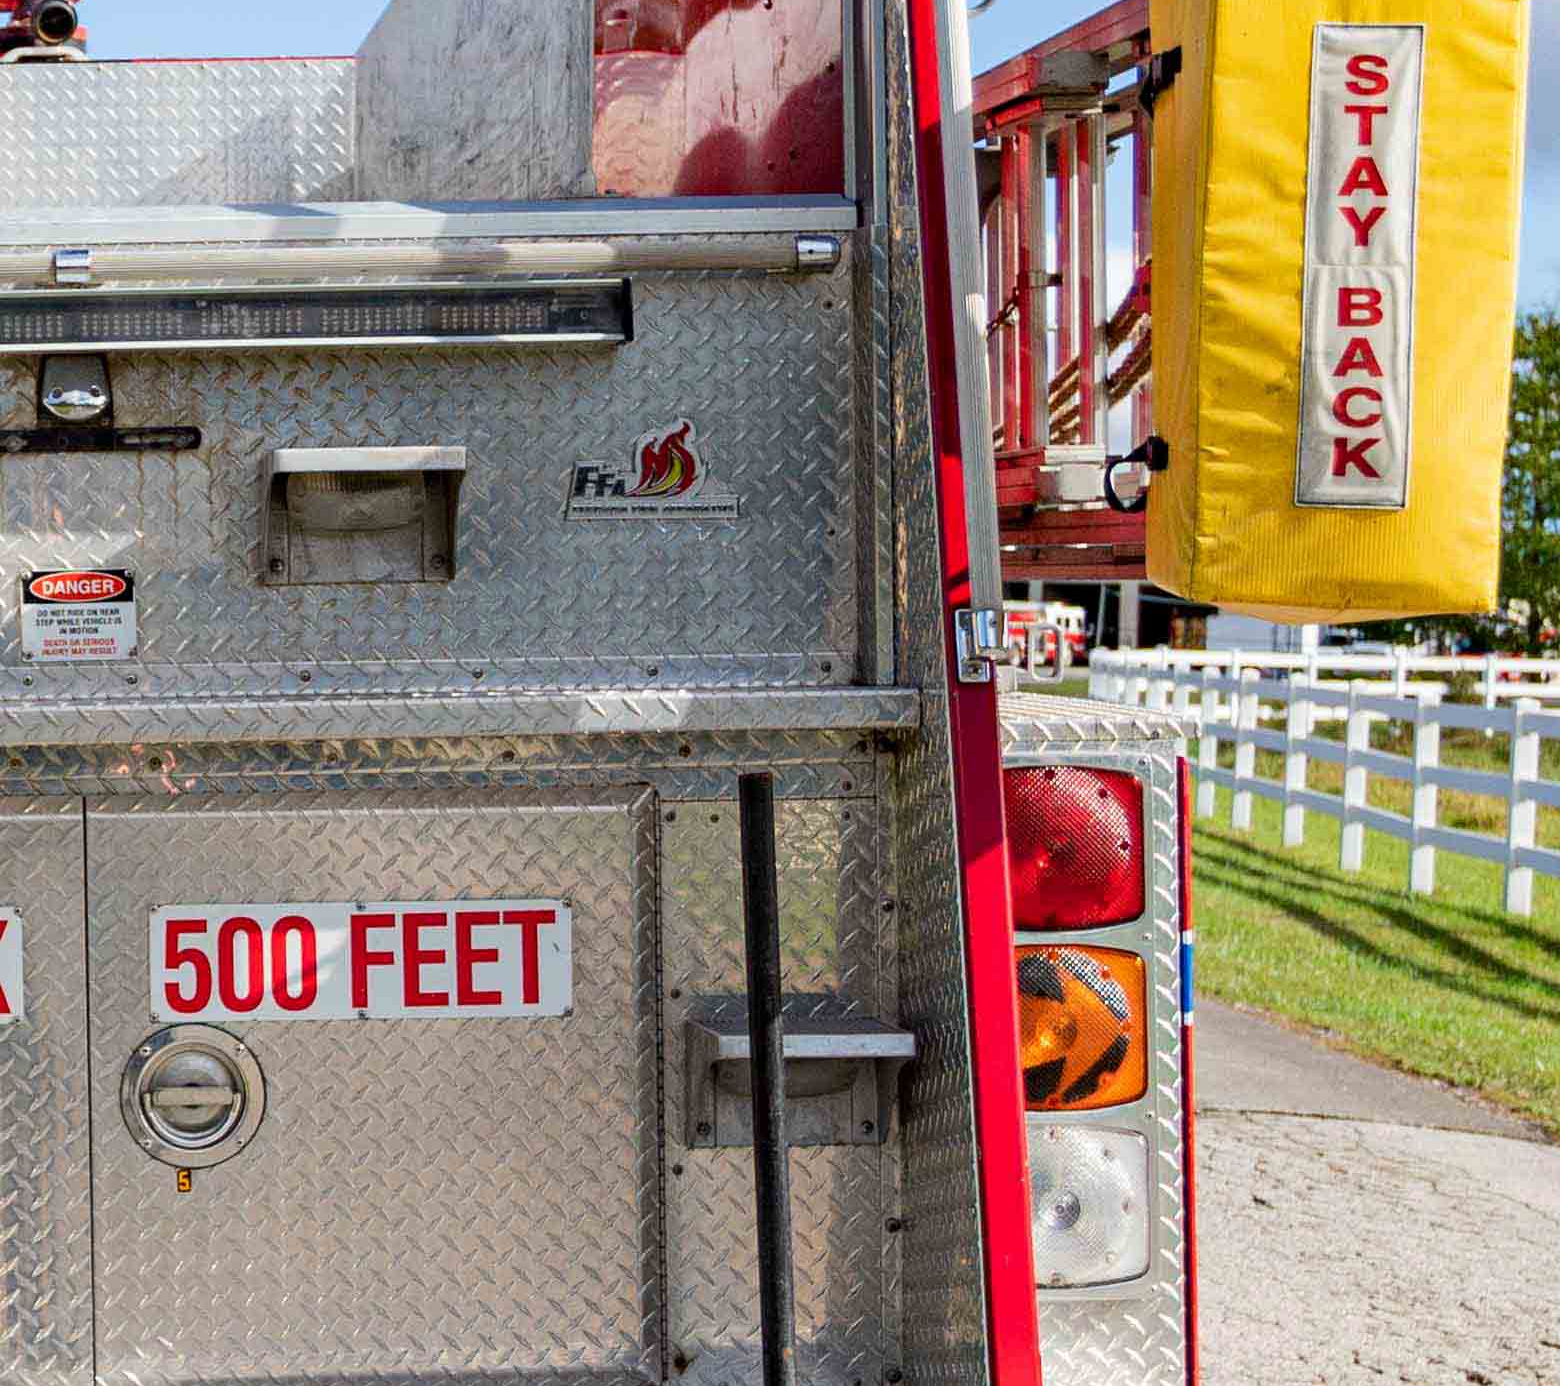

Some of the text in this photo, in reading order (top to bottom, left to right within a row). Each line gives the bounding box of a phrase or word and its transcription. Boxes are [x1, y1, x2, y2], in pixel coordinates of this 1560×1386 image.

[1330, 53, 1391, 480] STAY BACK
[42, 580, 115, 594] DANGER
[37, 608, 120, 617] DO NOT RIDE ON REAR
[56, 618, 79, 626] WHILE
[164, 909, 556, 1014] 500 FEET
[179, 1171, 190, 1190] 5
